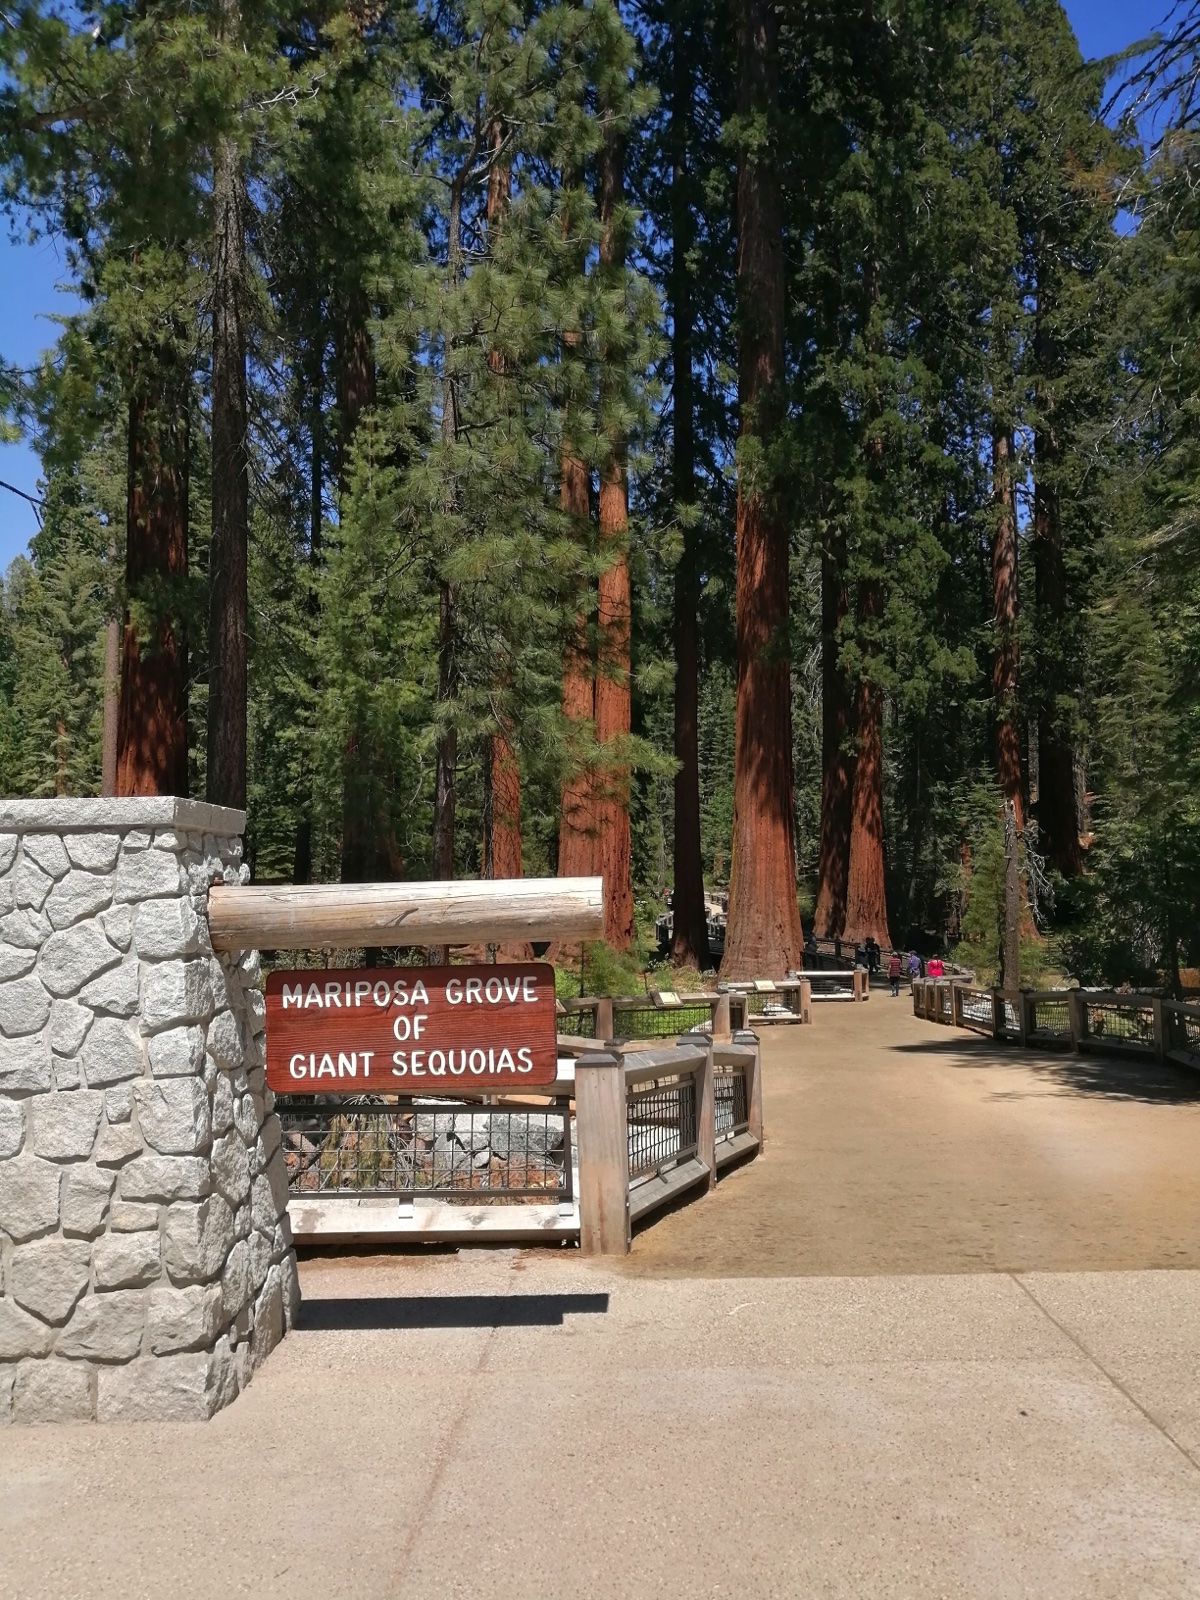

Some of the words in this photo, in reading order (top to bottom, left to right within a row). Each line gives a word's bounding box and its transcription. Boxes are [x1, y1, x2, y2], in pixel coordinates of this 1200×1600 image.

[282, 980, 430, 1009] MARIPOSA
[445, 976, 539, 1004] GROVE
[393, 1014, 429, 1041] OF
[289, 1051, 375, 1079] GIANT
[391, 1047, 534, 1077] SEQUOIAS
